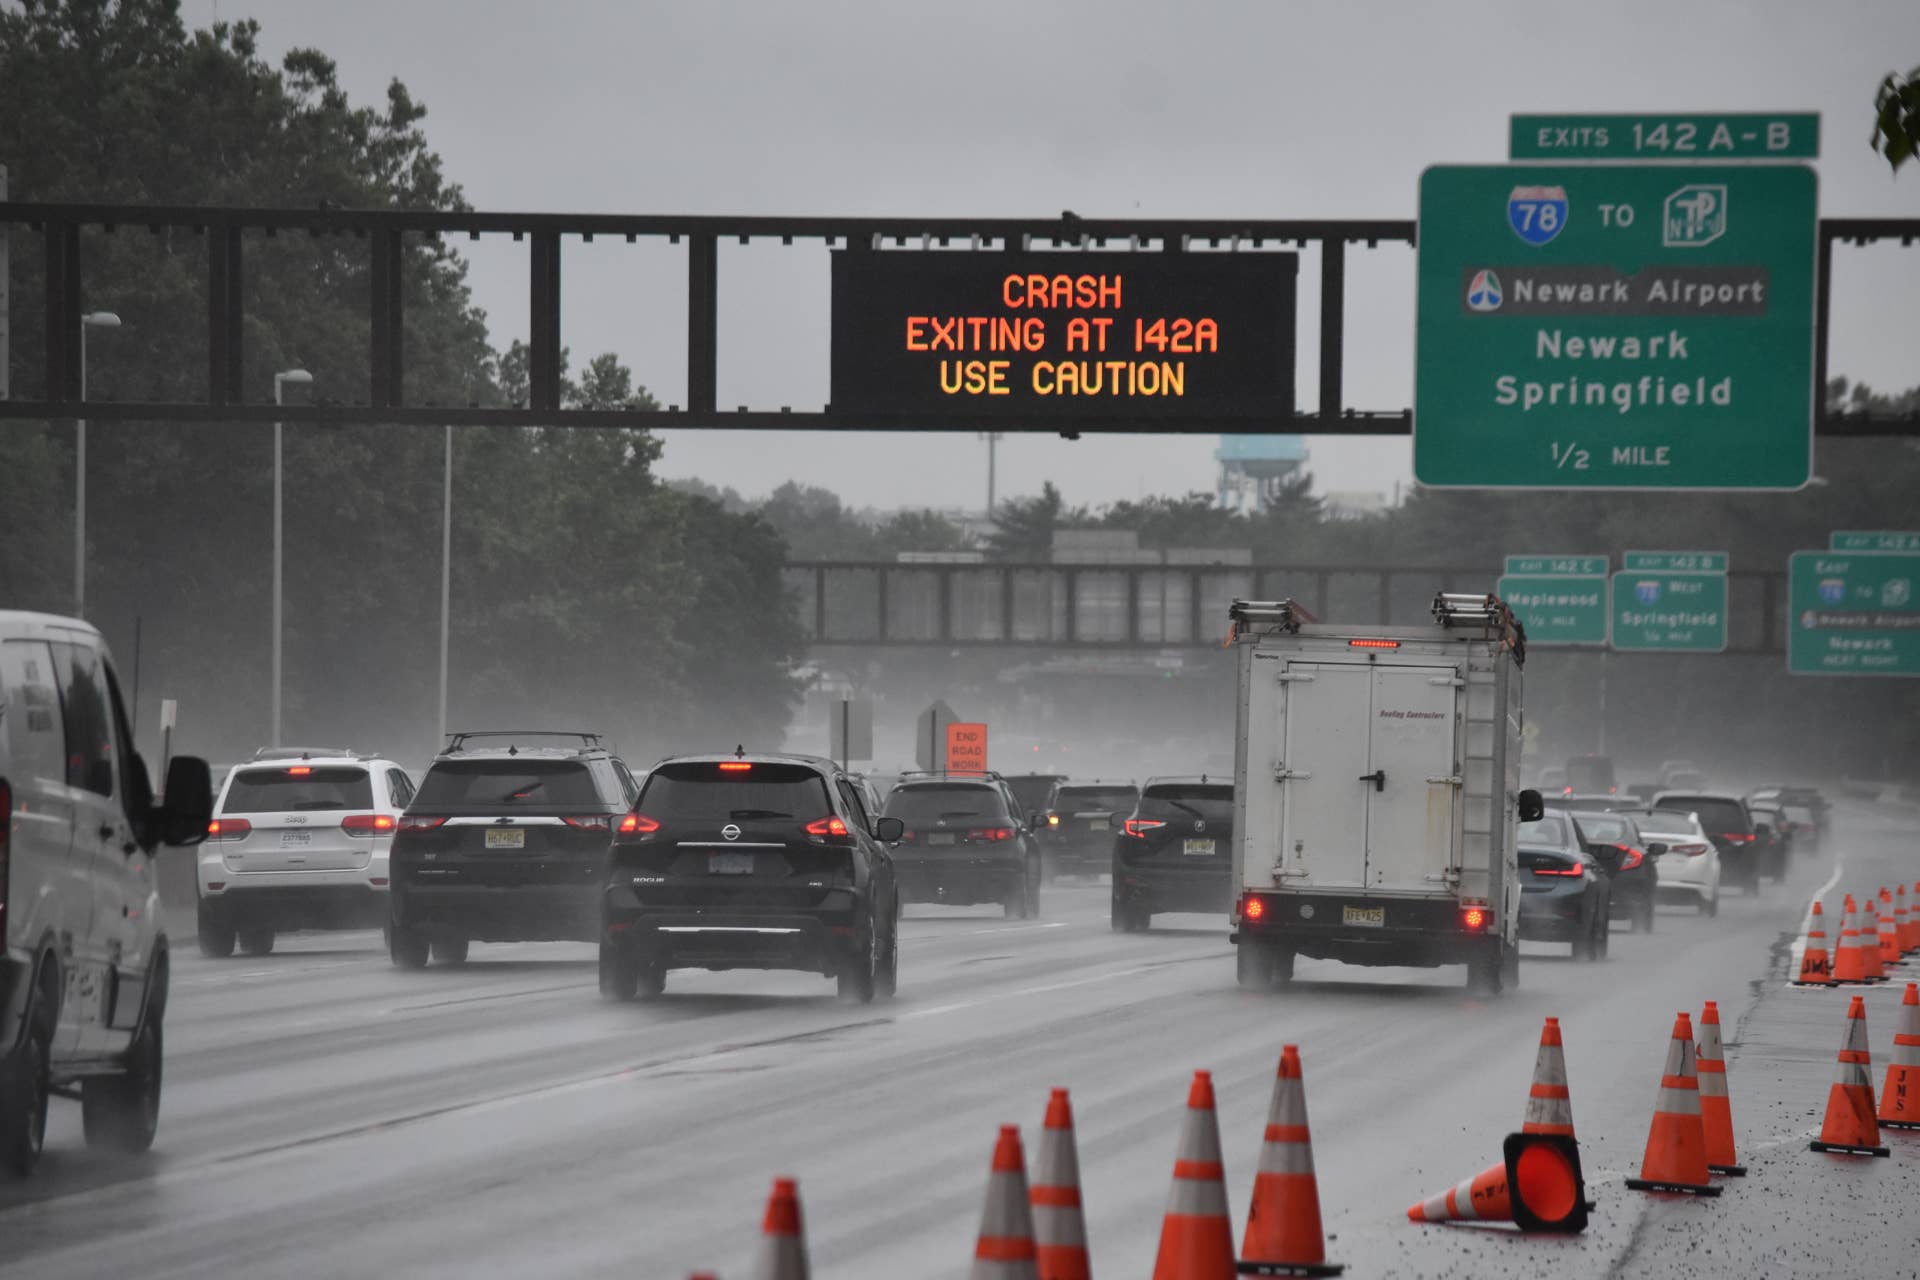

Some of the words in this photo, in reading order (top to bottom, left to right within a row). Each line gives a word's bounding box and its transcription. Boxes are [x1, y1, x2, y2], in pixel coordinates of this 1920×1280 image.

[1537, 127, 1609, 147] EXITS
[1631, 123, 1697, 151] 142
[1518, 204, 1558, 232] 78
[1599, 205, 1634, 228] TO
[1003, 274, 1122, 308] CRASH
[1513, 278, 1629, 302] Newark
[1648, 278, 1764, 306] Airport
[906, 317, 1045, 351] EXITING
[1067, 318, 1113, 351] AT
[1135, 318, 1218, 352] 142A
[1536, 330, 1689, 359] Newark
[940, 360, 1010, 394] USE
[1032, 361, 1185, 396] CAUTION
[1495, 375, 1732, 413] Springfield
[1551, 443, 1590, 470] 1/2
[1612, 446, 1671, 466] MILE
[1622, 610, 1718, 628] Springfield
[956, 732, 978, 741] END
[952, 746, 982, 756] ROAD
[952, 761, 982, 770] WORK
